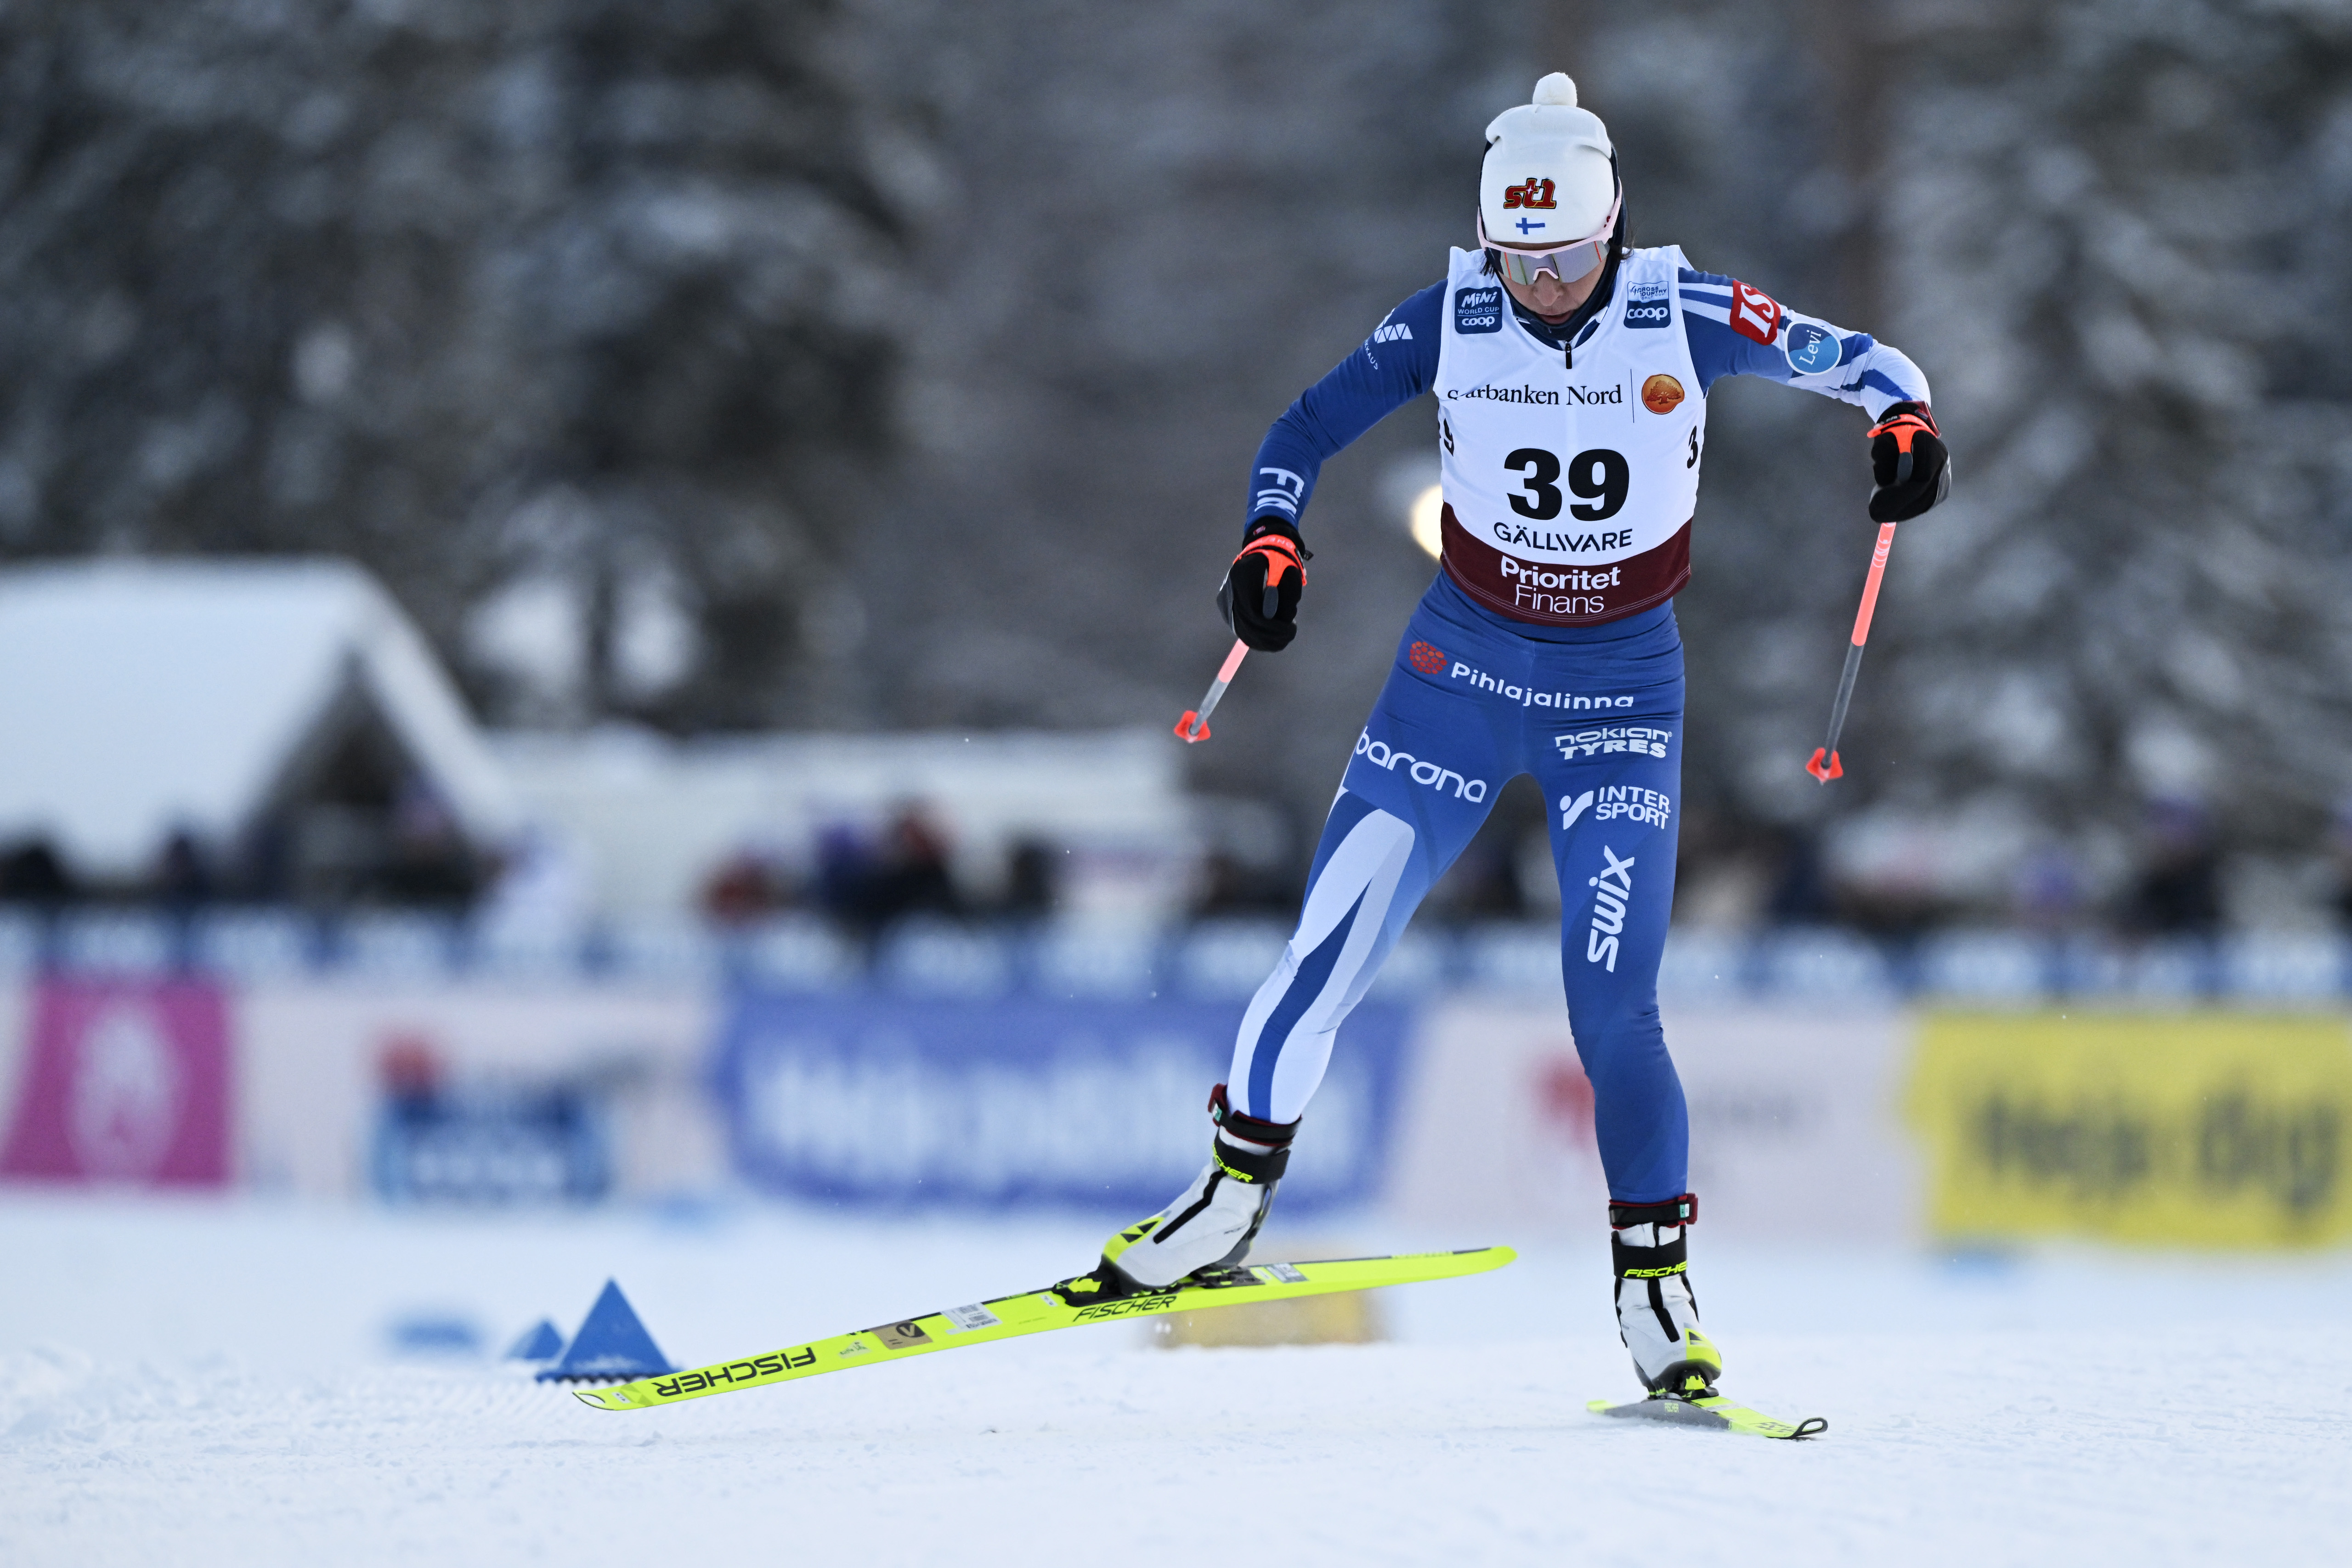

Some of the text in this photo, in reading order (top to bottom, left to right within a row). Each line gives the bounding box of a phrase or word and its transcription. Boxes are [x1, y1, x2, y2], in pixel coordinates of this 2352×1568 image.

[1504, 177, 1557, 209] st1
[1640, 289, 1667, 297] OUNTRY
[1462, 316, 1495, 327] coop
[1627, 307, 1668, 321] coop
[1799, 329, 1821, 365] Levi
[1447, 384, 1623, 405] Sarbanken Nord
[1255, 467, 1305, 519] FIN
[1504, 448, 1629, 521] 39
[1493, 522, 1633, 552] GÄLLIVARE
[1501, 555, 1621, 590] Prioritet
[1515, 583, 1604, 614] Finans
[1451, 662, 1634, 709] Pihlajalinna
[1559, 739, 1667, 760] TYRES
[1599, 786, 1669, 813] INTER
[1595, 803, 1668, 830] SPORT
[1073, 1295, 1177, 1322] FISCHER
[652, 1347, 816, 1397] FISCHER
